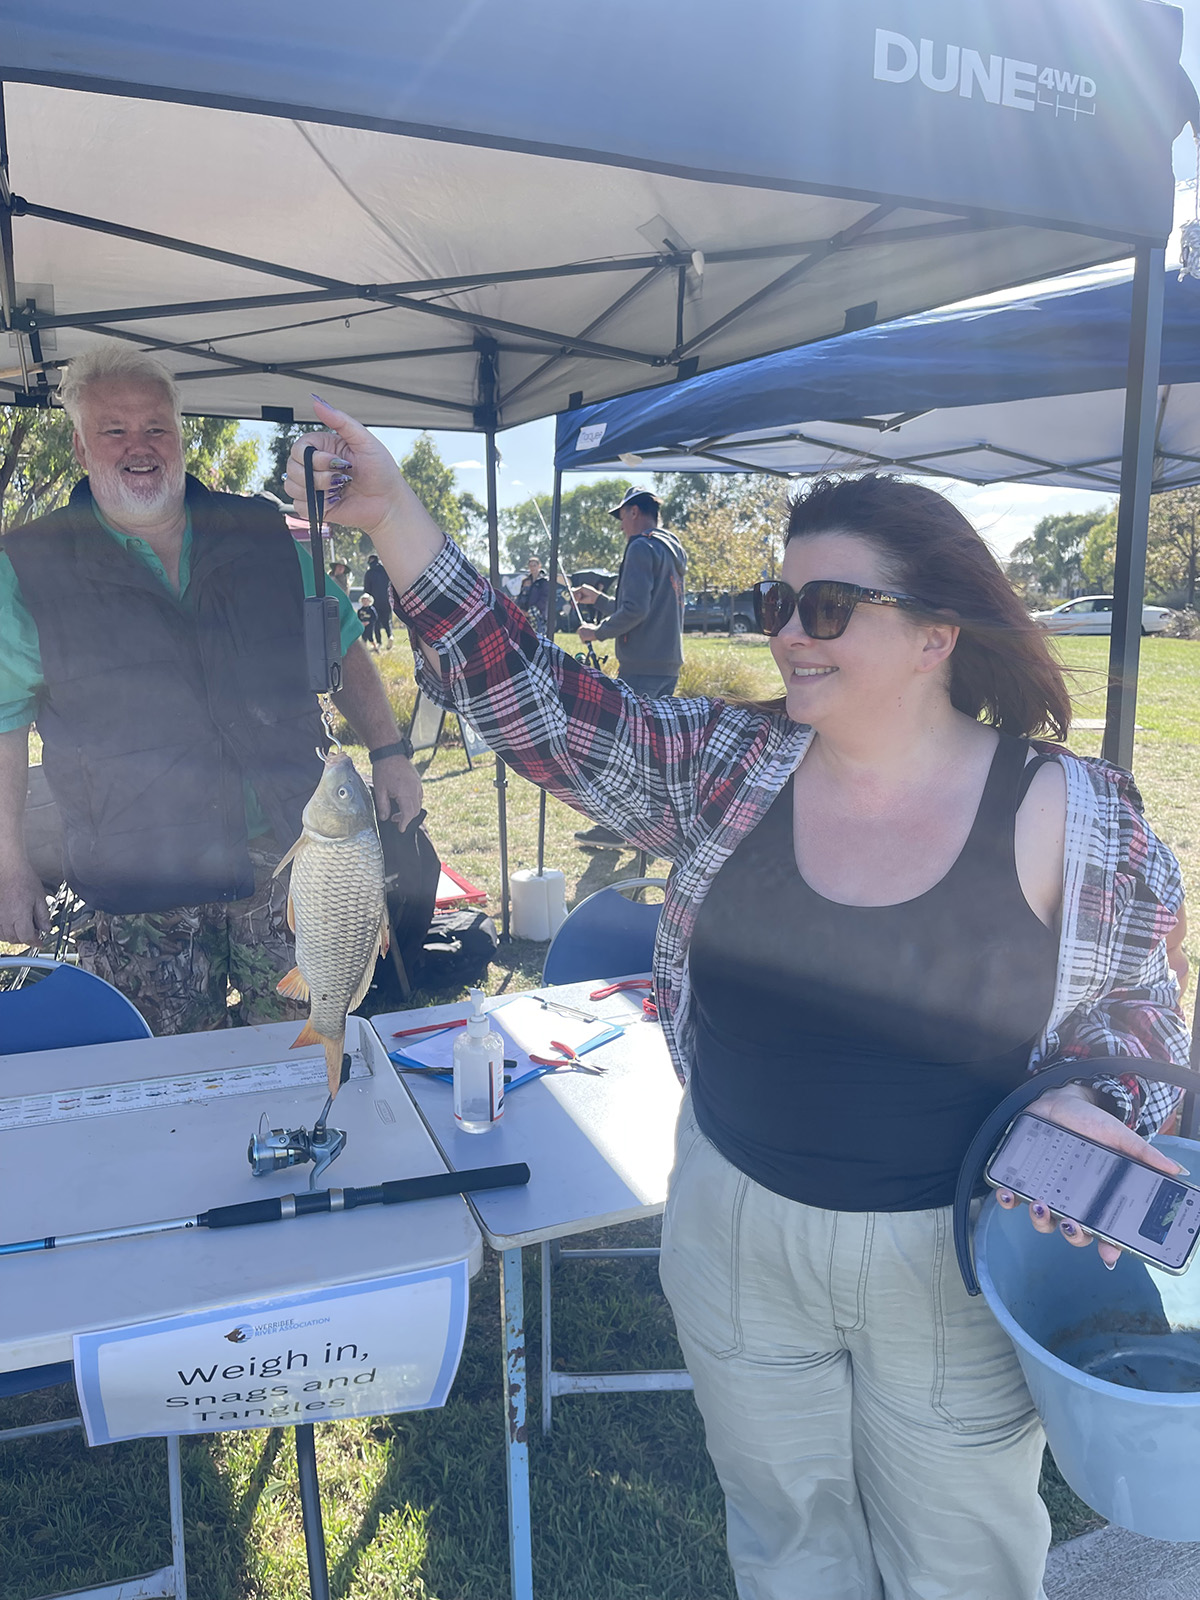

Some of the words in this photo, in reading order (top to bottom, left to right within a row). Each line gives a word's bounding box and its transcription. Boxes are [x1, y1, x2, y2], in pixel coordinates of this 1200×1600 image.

[873, 28, 1037, 112] DUNE
[1038, 66, 1097, 98] 4WD
[254, 1327, 277, 1337] RIVER
[279, 1317, 331, 1332] ASSOCIATION
[177, 1350, 308, 1386] Weigh
[324, 1342, 369, 1364] in,
[303, 1368, 377, 1392] and
[192, 1397, 346, 1422] Tangles
